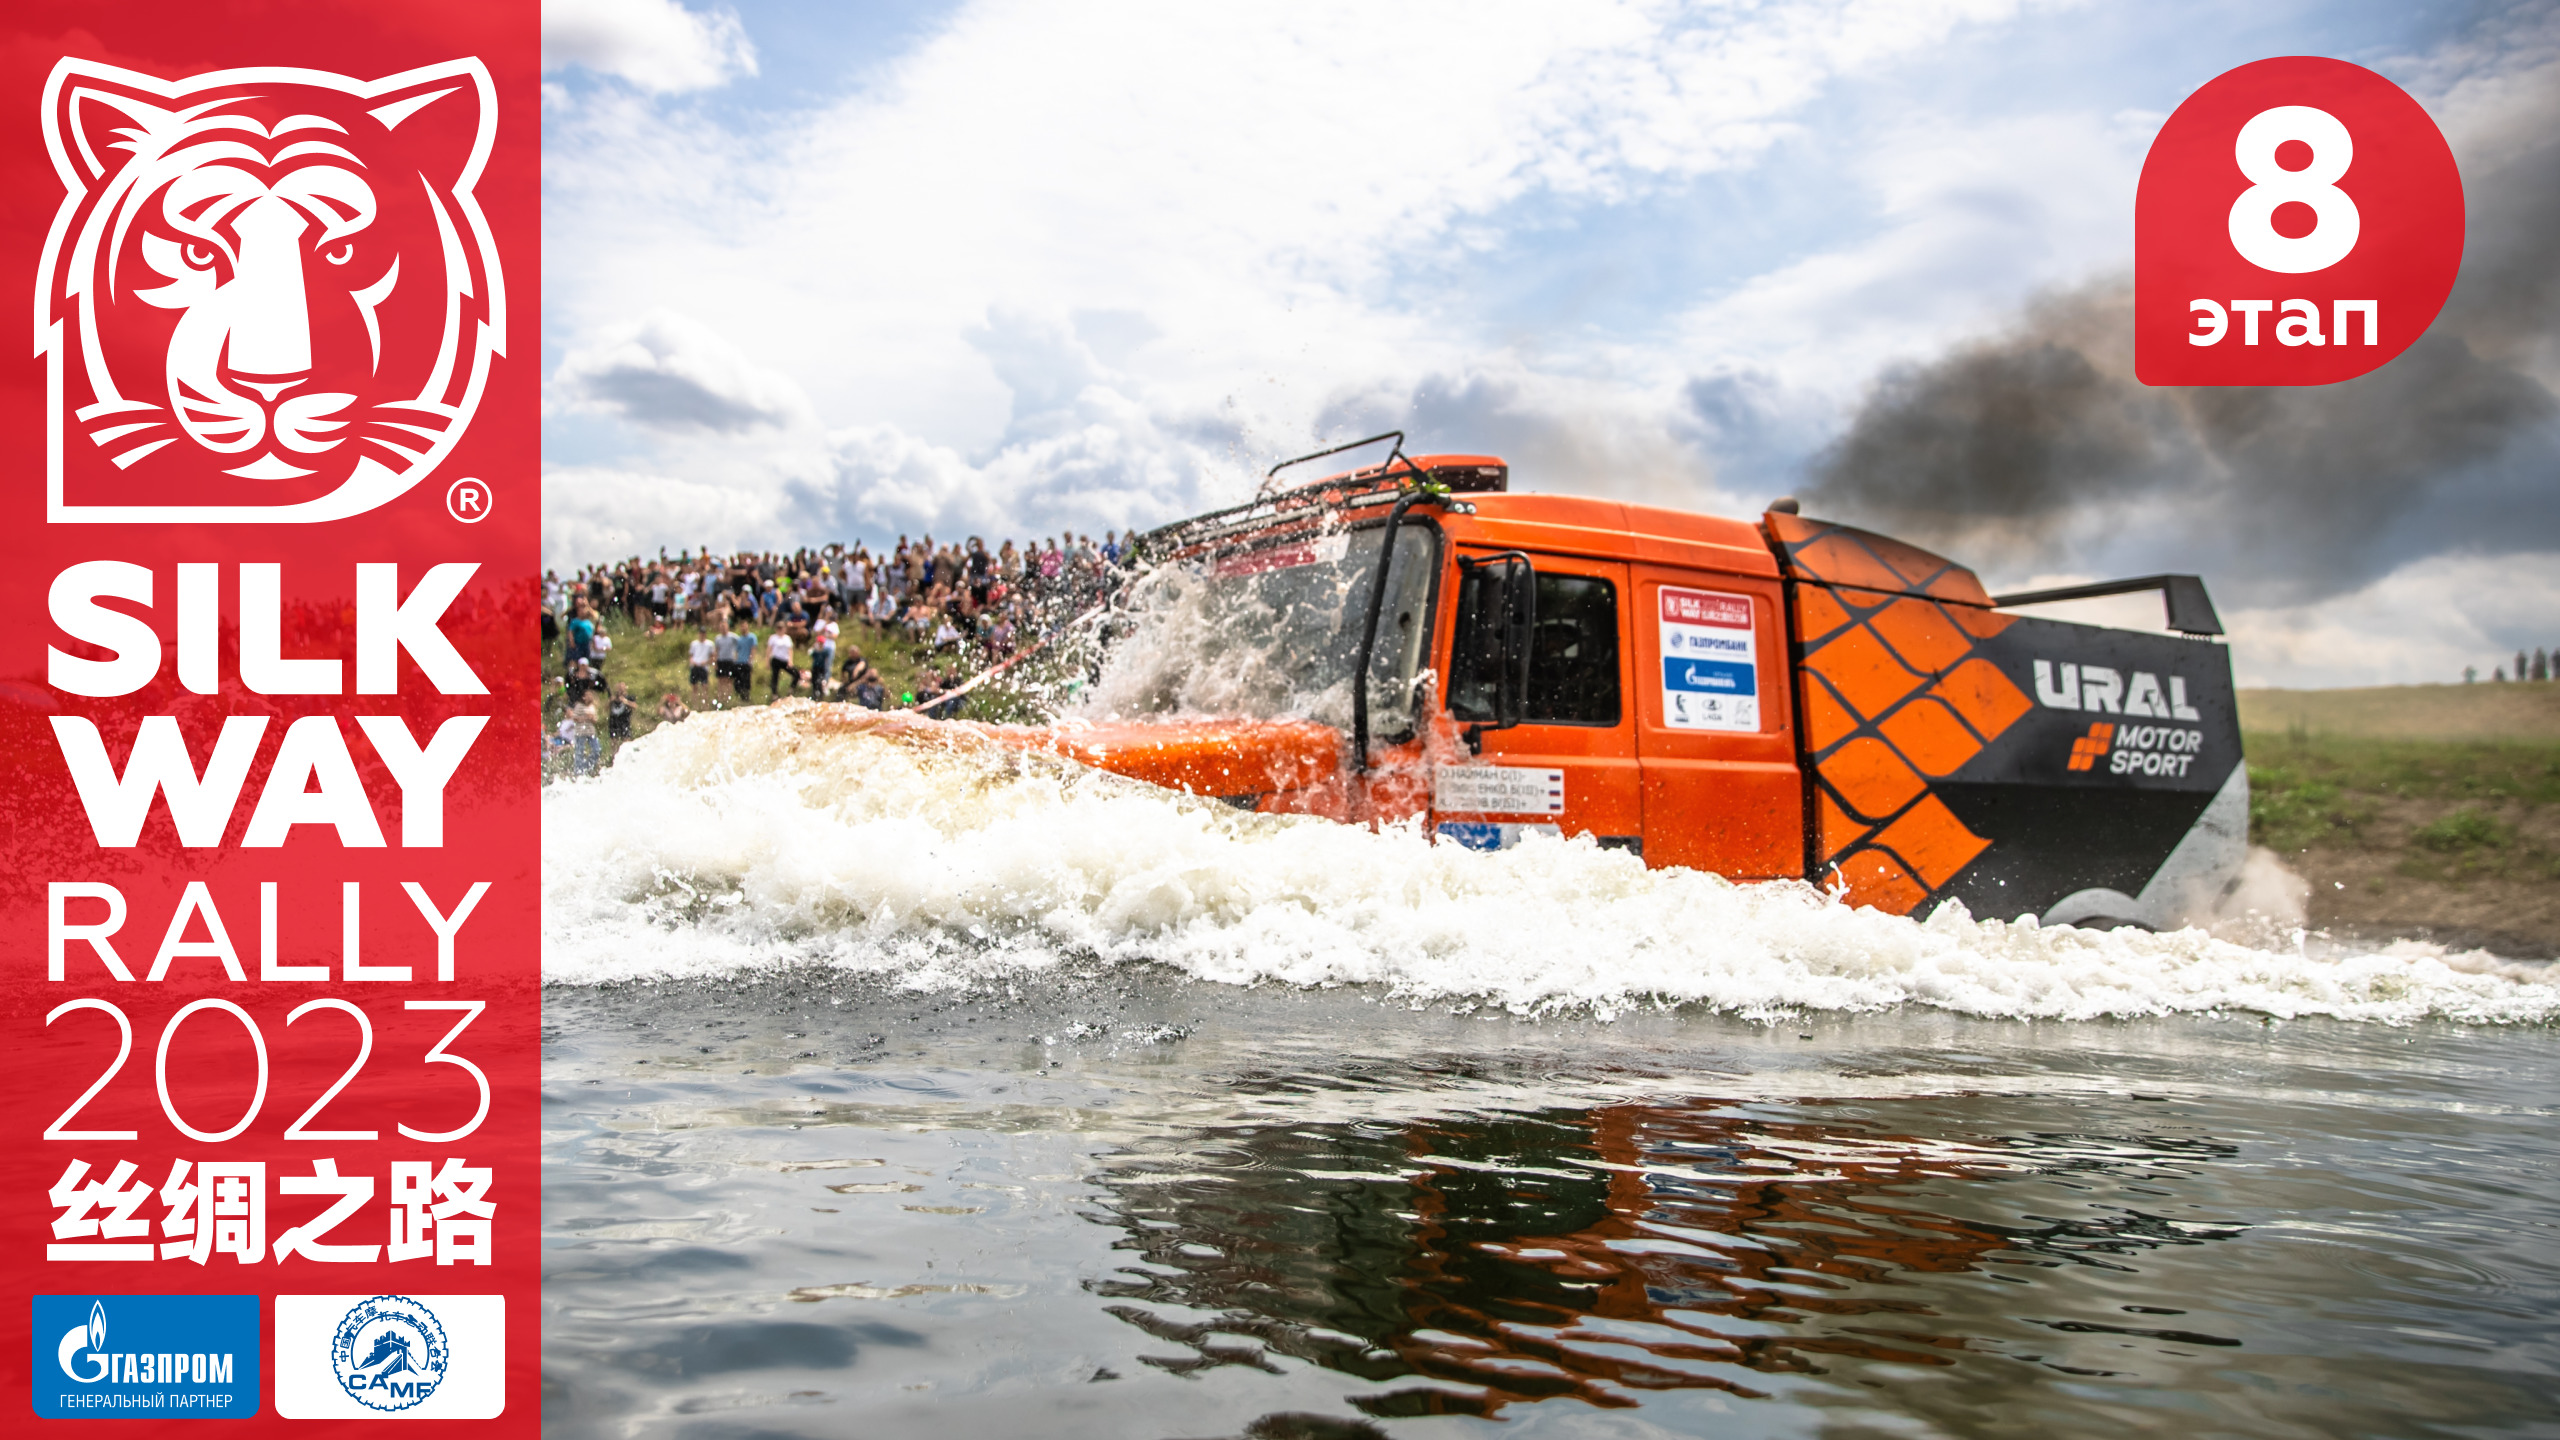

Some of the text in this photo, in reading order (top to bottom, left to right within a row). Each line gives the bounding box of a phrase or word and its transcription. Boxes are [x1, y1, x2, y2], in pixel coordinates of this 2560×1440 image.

[2033, 659, 2201, 722] URAL
[2115, 724, 2204, 753] MOTOR
[2109, 749, 2195, 777] SPORT
